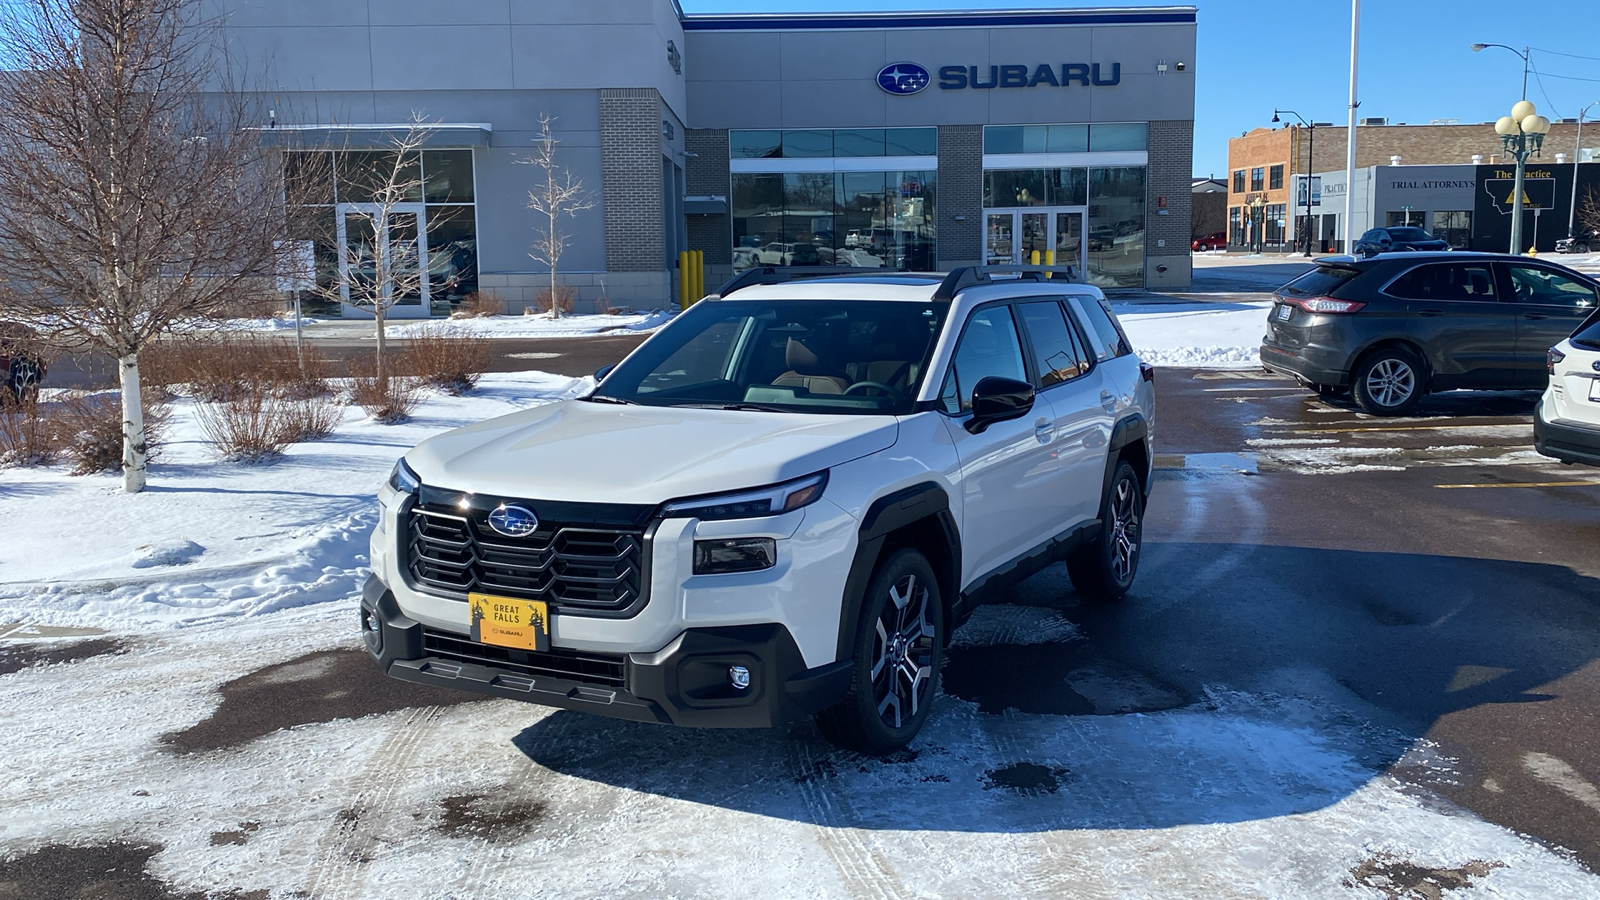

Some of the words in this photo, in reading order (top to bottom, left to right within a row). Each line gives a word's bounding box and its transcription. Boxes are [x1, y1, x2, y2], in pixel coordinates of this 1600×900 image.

[939, 63, 1121, 90] SUBARU
[1494, 170, 1512, 178] The
[1524, 169, 1551, 178] actice
[1324, 183, 1348, 194] PRACTIC
[1391, 181, 1419, 189] TRIAL
[1421, 180, 1475, 189] ATTORNEYS
[494, 603, 519, 614] GREAT
[494, 612, 520, 623] FALLS
[499, 629, 523, 637] SUBARU
